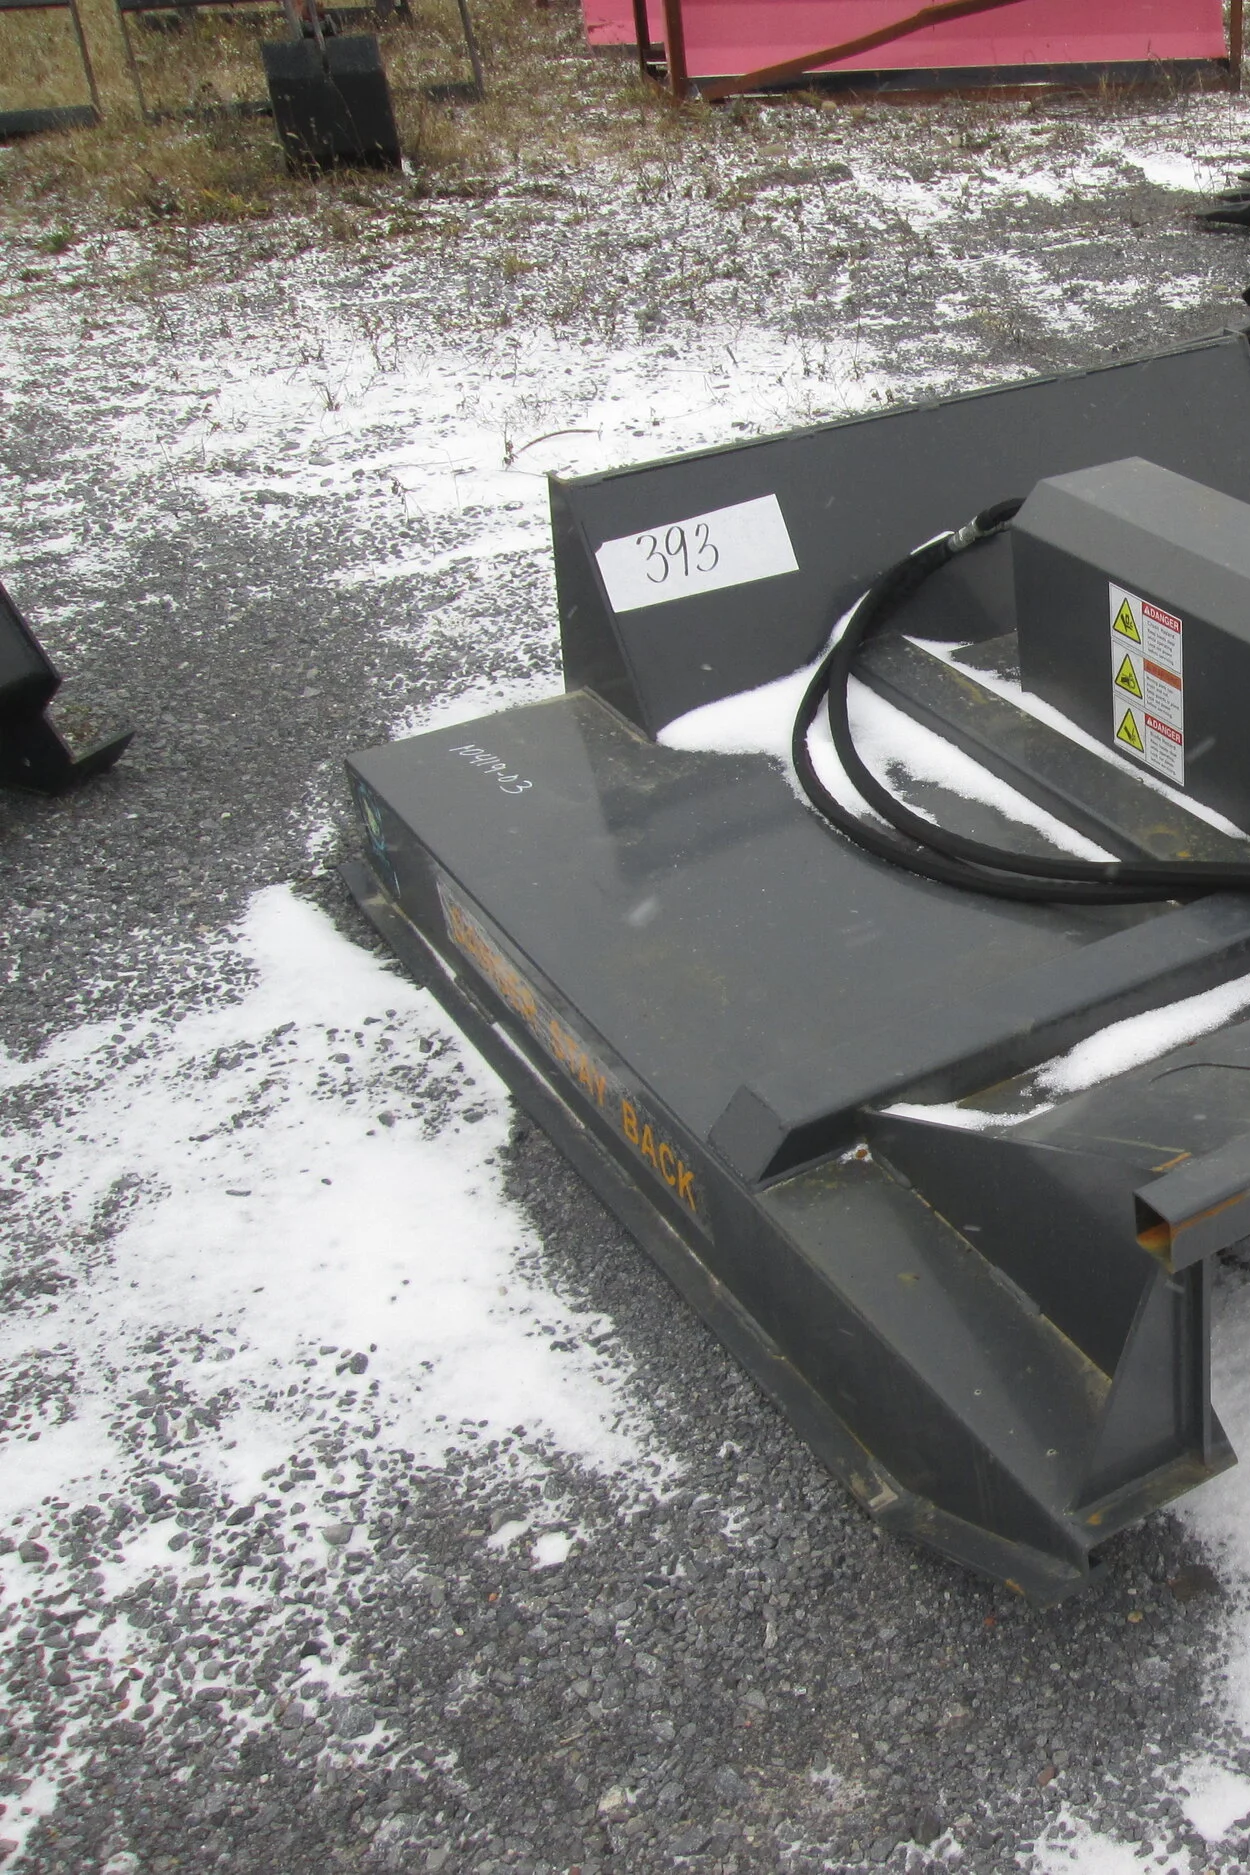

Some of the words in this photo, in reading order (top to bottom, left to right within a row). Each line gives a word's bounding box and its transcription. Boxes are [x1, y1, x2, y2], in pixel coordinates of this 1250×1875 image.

[635, 522, 719, 583] 393
[1148, 609, 1179, 632] DANGER
[1152, 719, 1181, 743] DANGER
[550, 1019, 608, 1107] STAY
[621, 1099, 697, 1212] BACK
